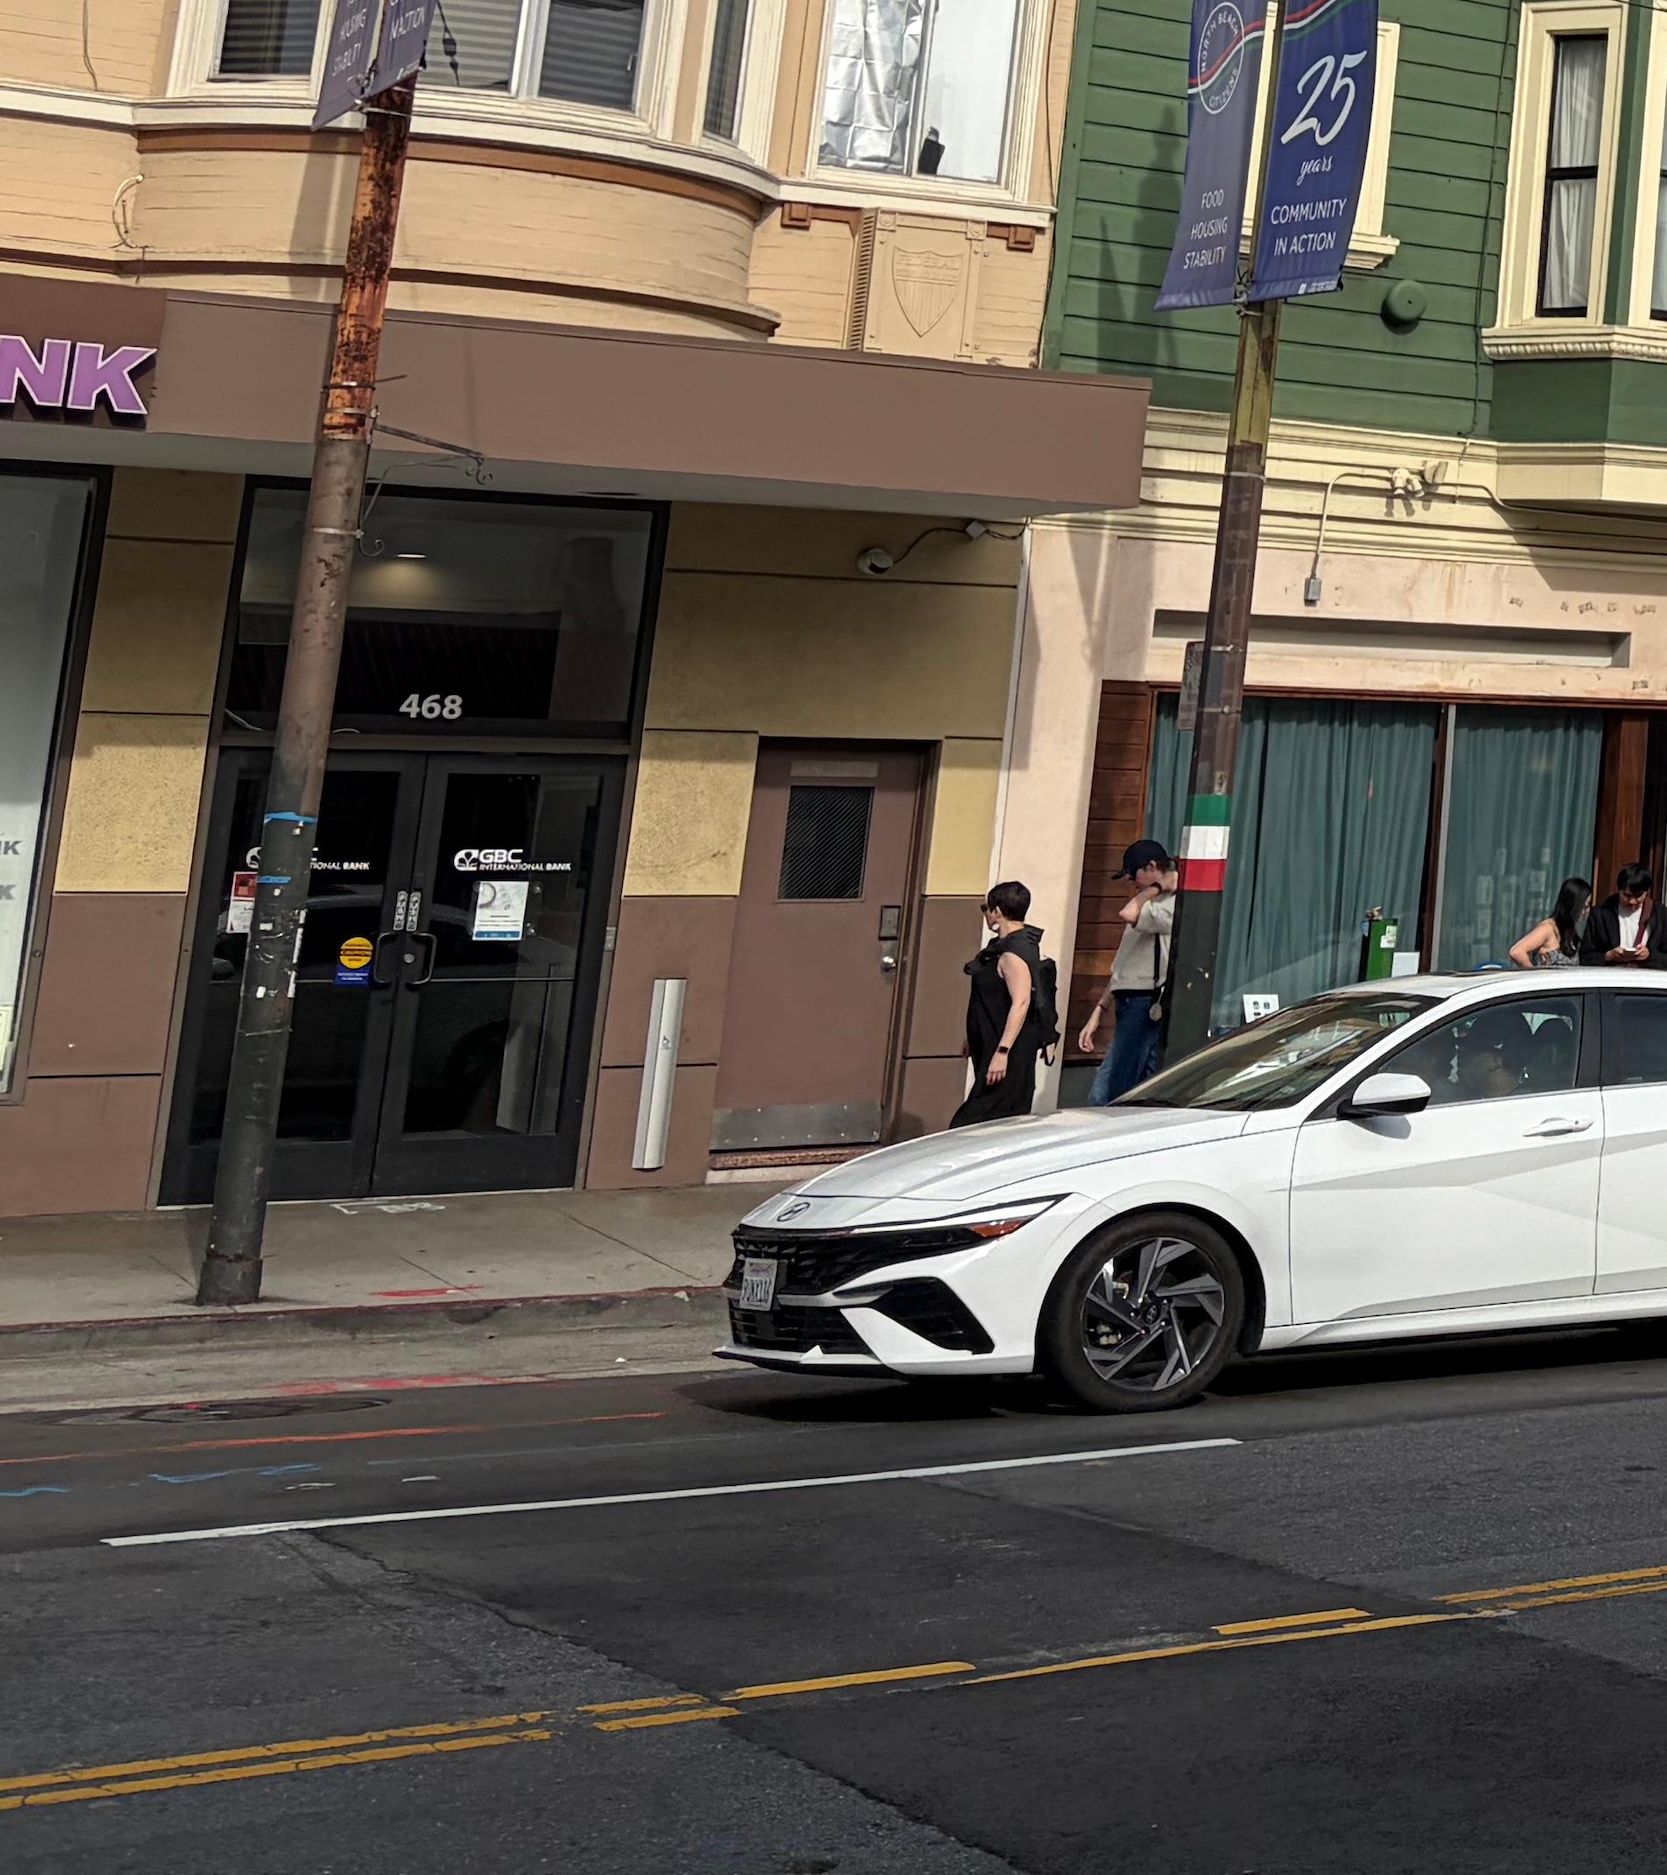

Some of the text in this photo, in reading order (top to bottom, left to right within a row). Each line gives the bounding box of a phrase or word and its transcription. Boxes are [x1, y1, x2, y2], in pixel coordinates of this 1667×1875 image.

[1217, 10, 1239, 38] BEACH
[1280, 50, 1367, 147] 25
[1296, 155, 1333, 186] years
[1201, 188, 1225, 210] FOOD
[1270, 197, 1348, 225] COMMUNITY
[1190, 216, 1228, 240] HOUSING
[1273, 231, 1337, 257] IN ACTION
[1183, 245, 1226, 269] STABILITY
[399, 693, 463, 720] 468
[342, 862, 371, 871] BANK
[478, 848, 524, 864] GBC
[478, 862, 572, 872] INTERNATIONAL BANK
